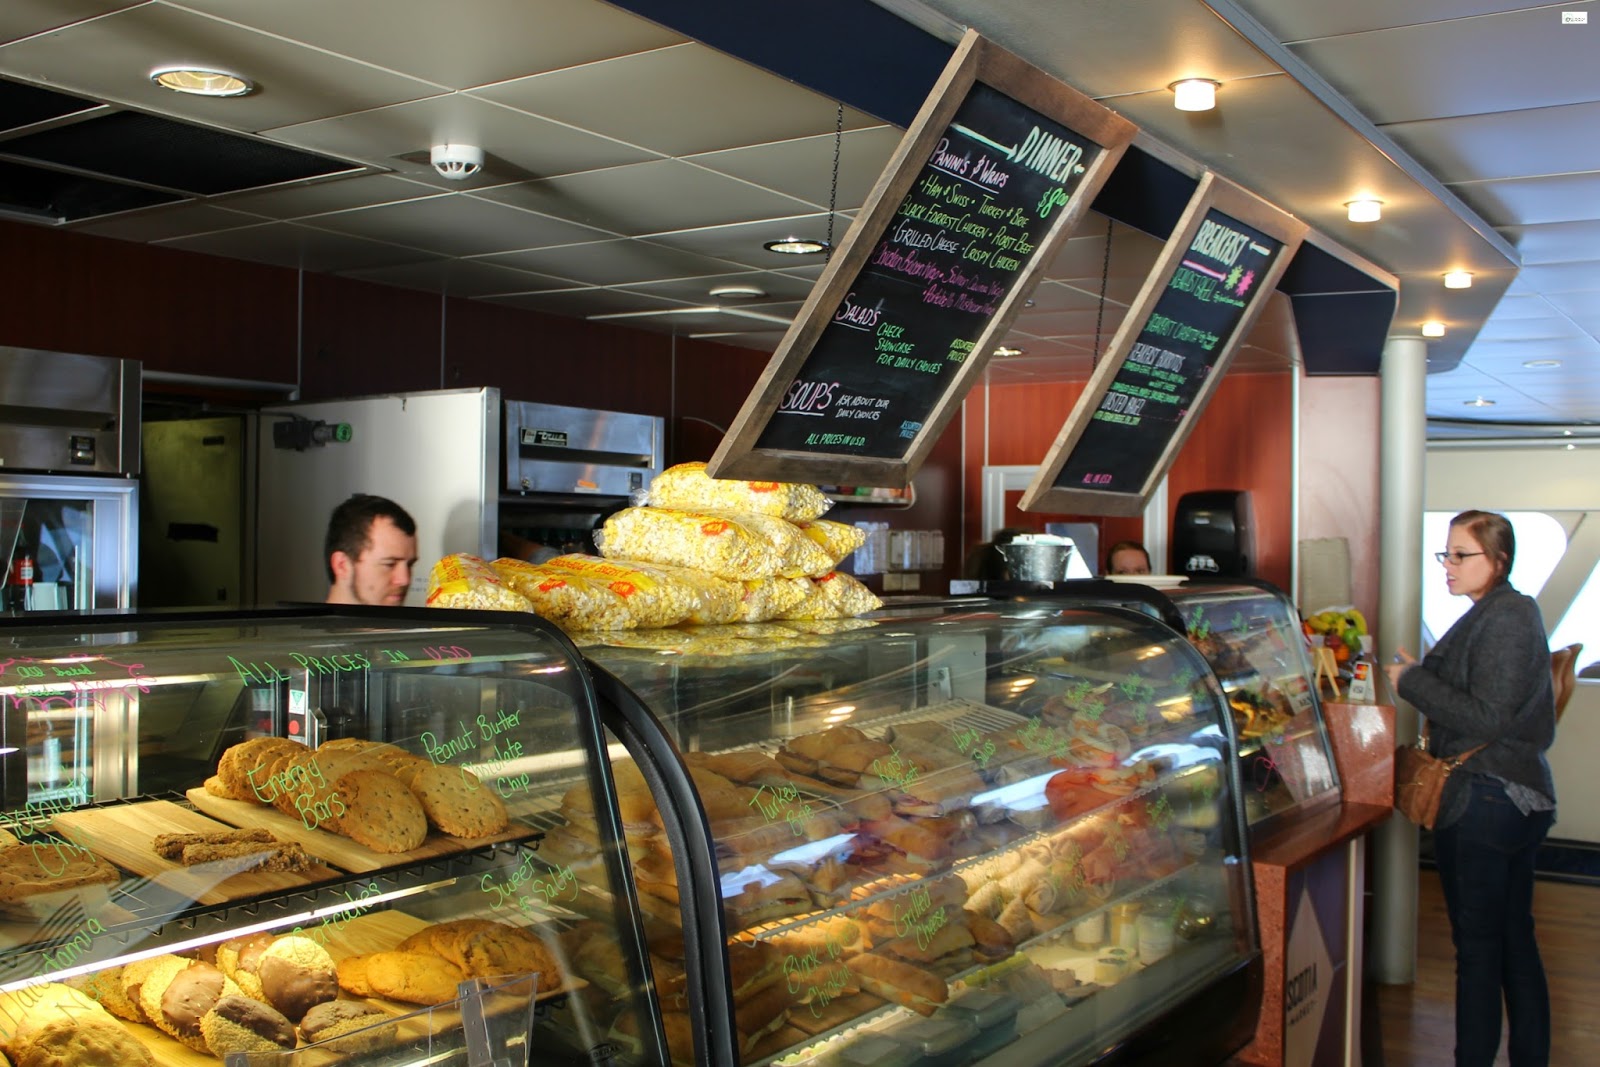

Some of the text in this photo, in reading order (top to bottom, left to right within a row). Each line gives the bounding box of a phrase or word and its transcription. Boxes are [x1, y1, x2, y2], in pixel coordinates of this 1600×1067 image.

[980, 156, 1009, 188] WRAPS
[1013, 125, 1083, 184] DINNER
[921, 175, 942, 197] HAM
[947, 183, 969, 208] SWISS
[979, 194, 1006, 220] TURKEY
[1008, 207, 1030, 229] BRIE
[898, 194, 926, 220] BLACK
[954, 214, 993, 239] CHICKEN
[991, 227, 1016, 250] ROAST
[1014, 232, 1035, 254] BEEF
[1190, 219, 1250, 267] BREAKFAST
[893, 219, 1020, 272] GRILLED CHEESE CRISPY CHICKEN
[834, 292, 882, 327] SALADS
[876, 322, 906, 339] CHECK
[874, 337, 916, 354] SHOWCASE
[876, 354, 943, 375] FOR DAILY CHOICES
[1127, 342, 1162, 366] REAKFAST
[780, 379, 841, 411] SOUPS
[835, 394, 890, 409] ASK ABOUT OUR
[835, 408, 881, 421] DAILY CHOICES
[804, 433, 820, 445] ALL
[819, 433, 844, 445] PRICES
[841, 434, 852, 445] IN
[226, 645, 472, 687] ALL PRICES IN USD
[420, 709, 522, 769] Peanut Butter
[247, 758, 326, 803] Energy
[459, 739, 524, 791] Chocolate
[496, 770, 531, 801] Chip
[0, 764, 98, 839] hocolate
[294, 790, 346, 832] Bars
[749, 781, 801, 824] Turkey
[480, 851, 538, 910] Sweet
[531, 863, 579, 910] Salty
[291, 880, 382, 964] Oatcakes
